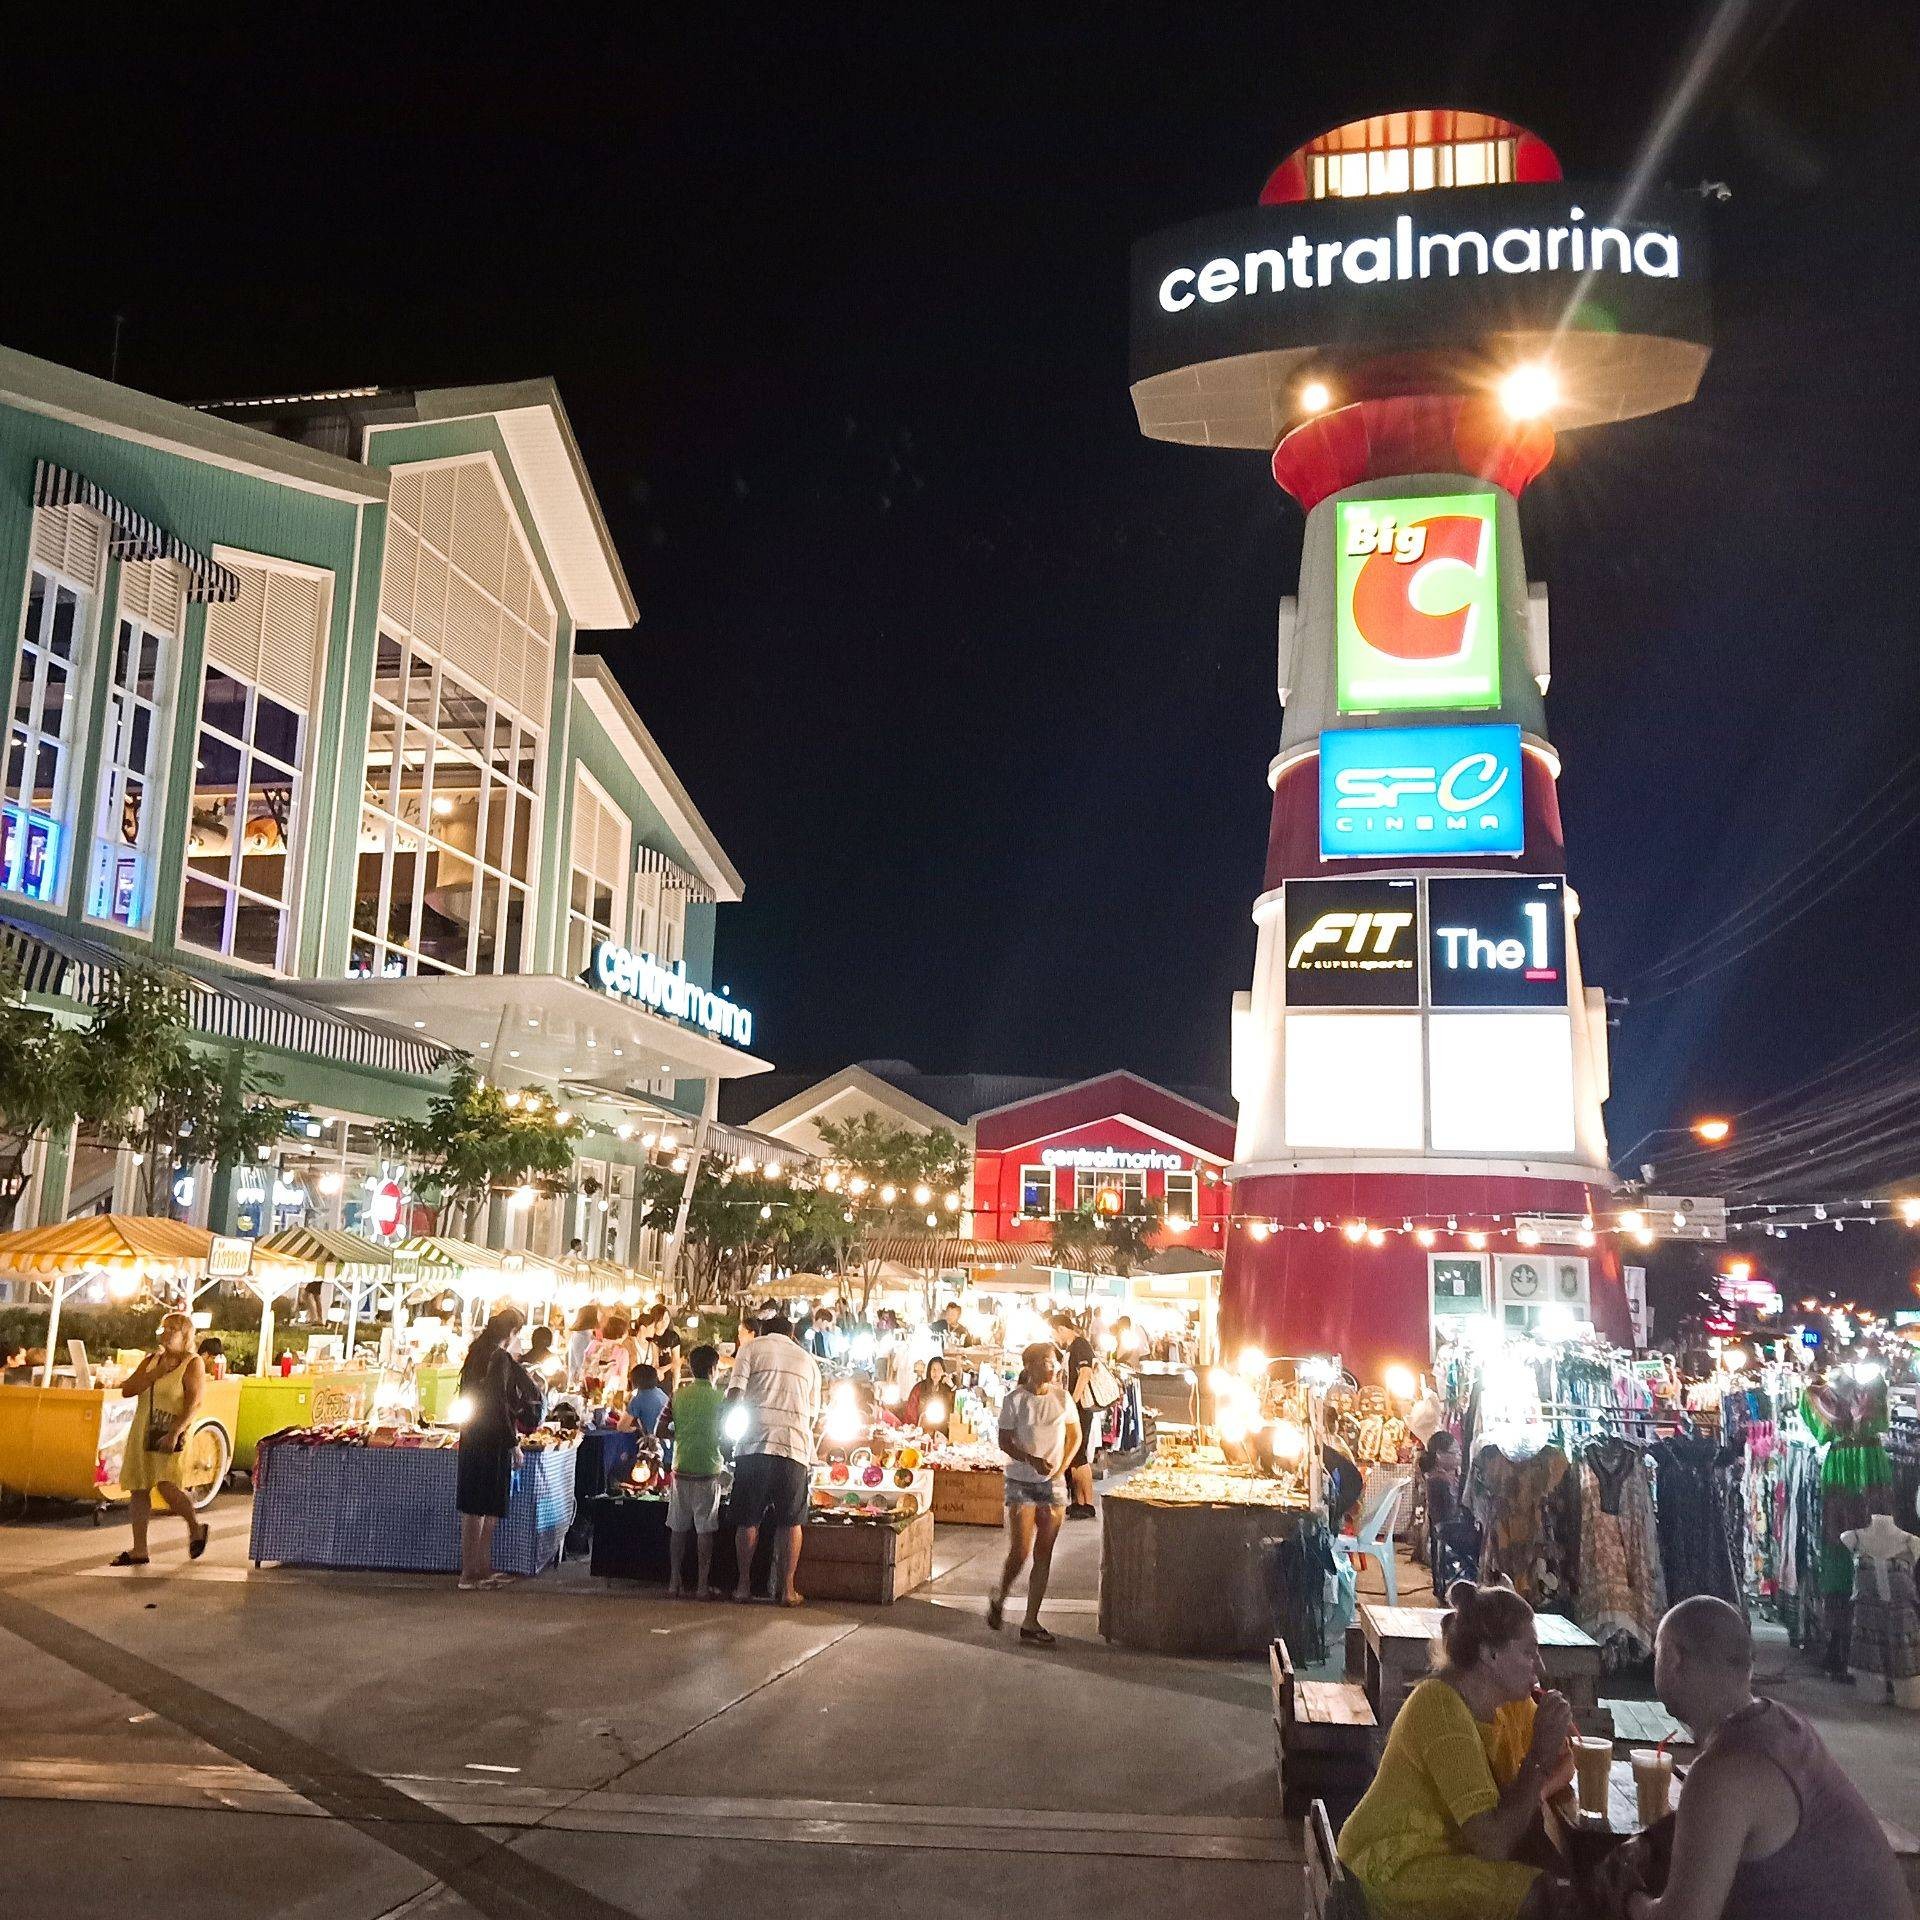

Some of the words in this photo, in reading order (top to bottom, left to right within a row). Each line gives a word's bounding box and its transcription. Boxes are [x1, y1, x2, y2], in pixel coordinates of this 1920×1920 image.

[1158, 206, 1680, 313] centralmarina
[1346, 519, 1427, 564] Big
[1353, 515, 1484, 664] C
[1288, 913, 1412, 968] FIT
[599, 940, 752, 1046] centralmarina
[1041, 1145, 1182, 1169] centralmarina
